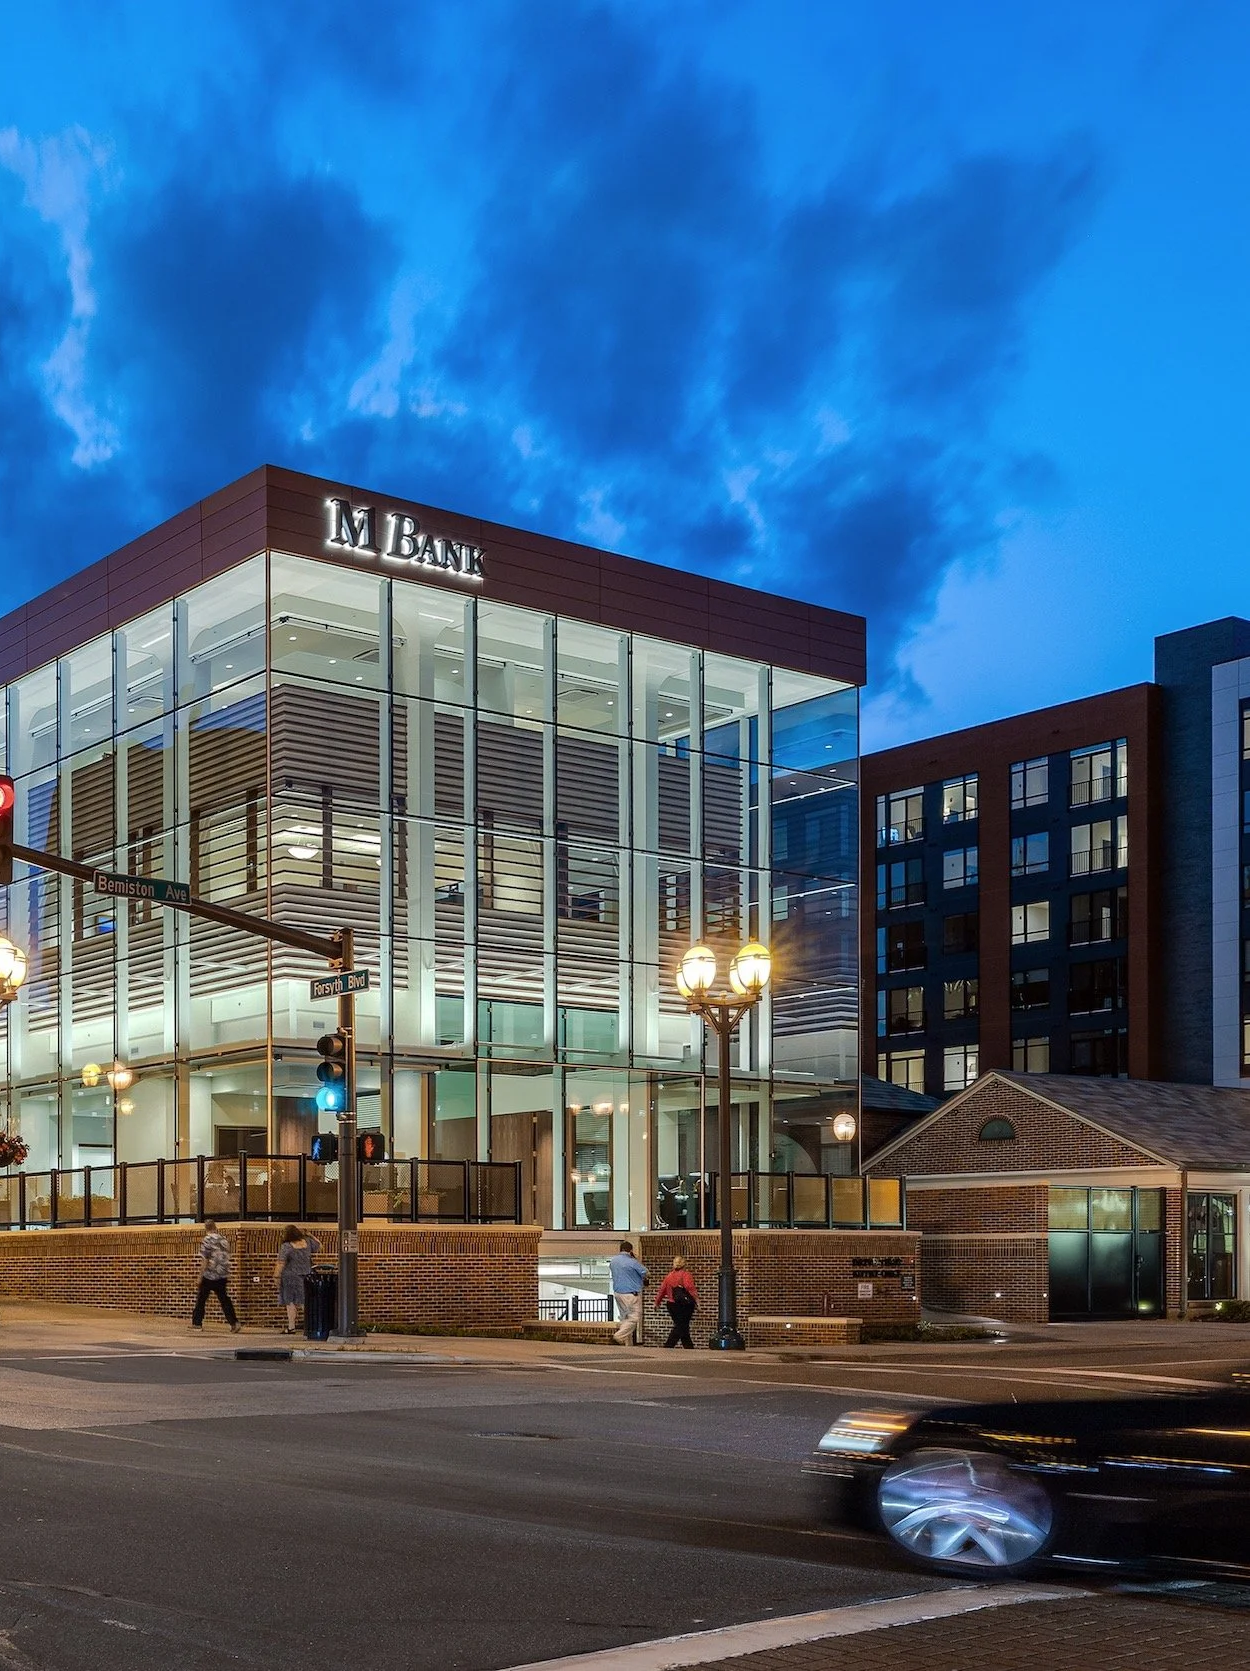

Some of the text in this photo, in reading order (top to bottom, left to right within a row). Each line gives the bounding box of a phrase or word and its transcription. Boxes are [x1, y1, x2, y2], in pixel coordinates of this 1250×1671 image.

[327, 497, 382, 554] M
[98, 875, 187, 901] Bemiston Ave
[314, 973, 365, 996] Forsyth Blvd
